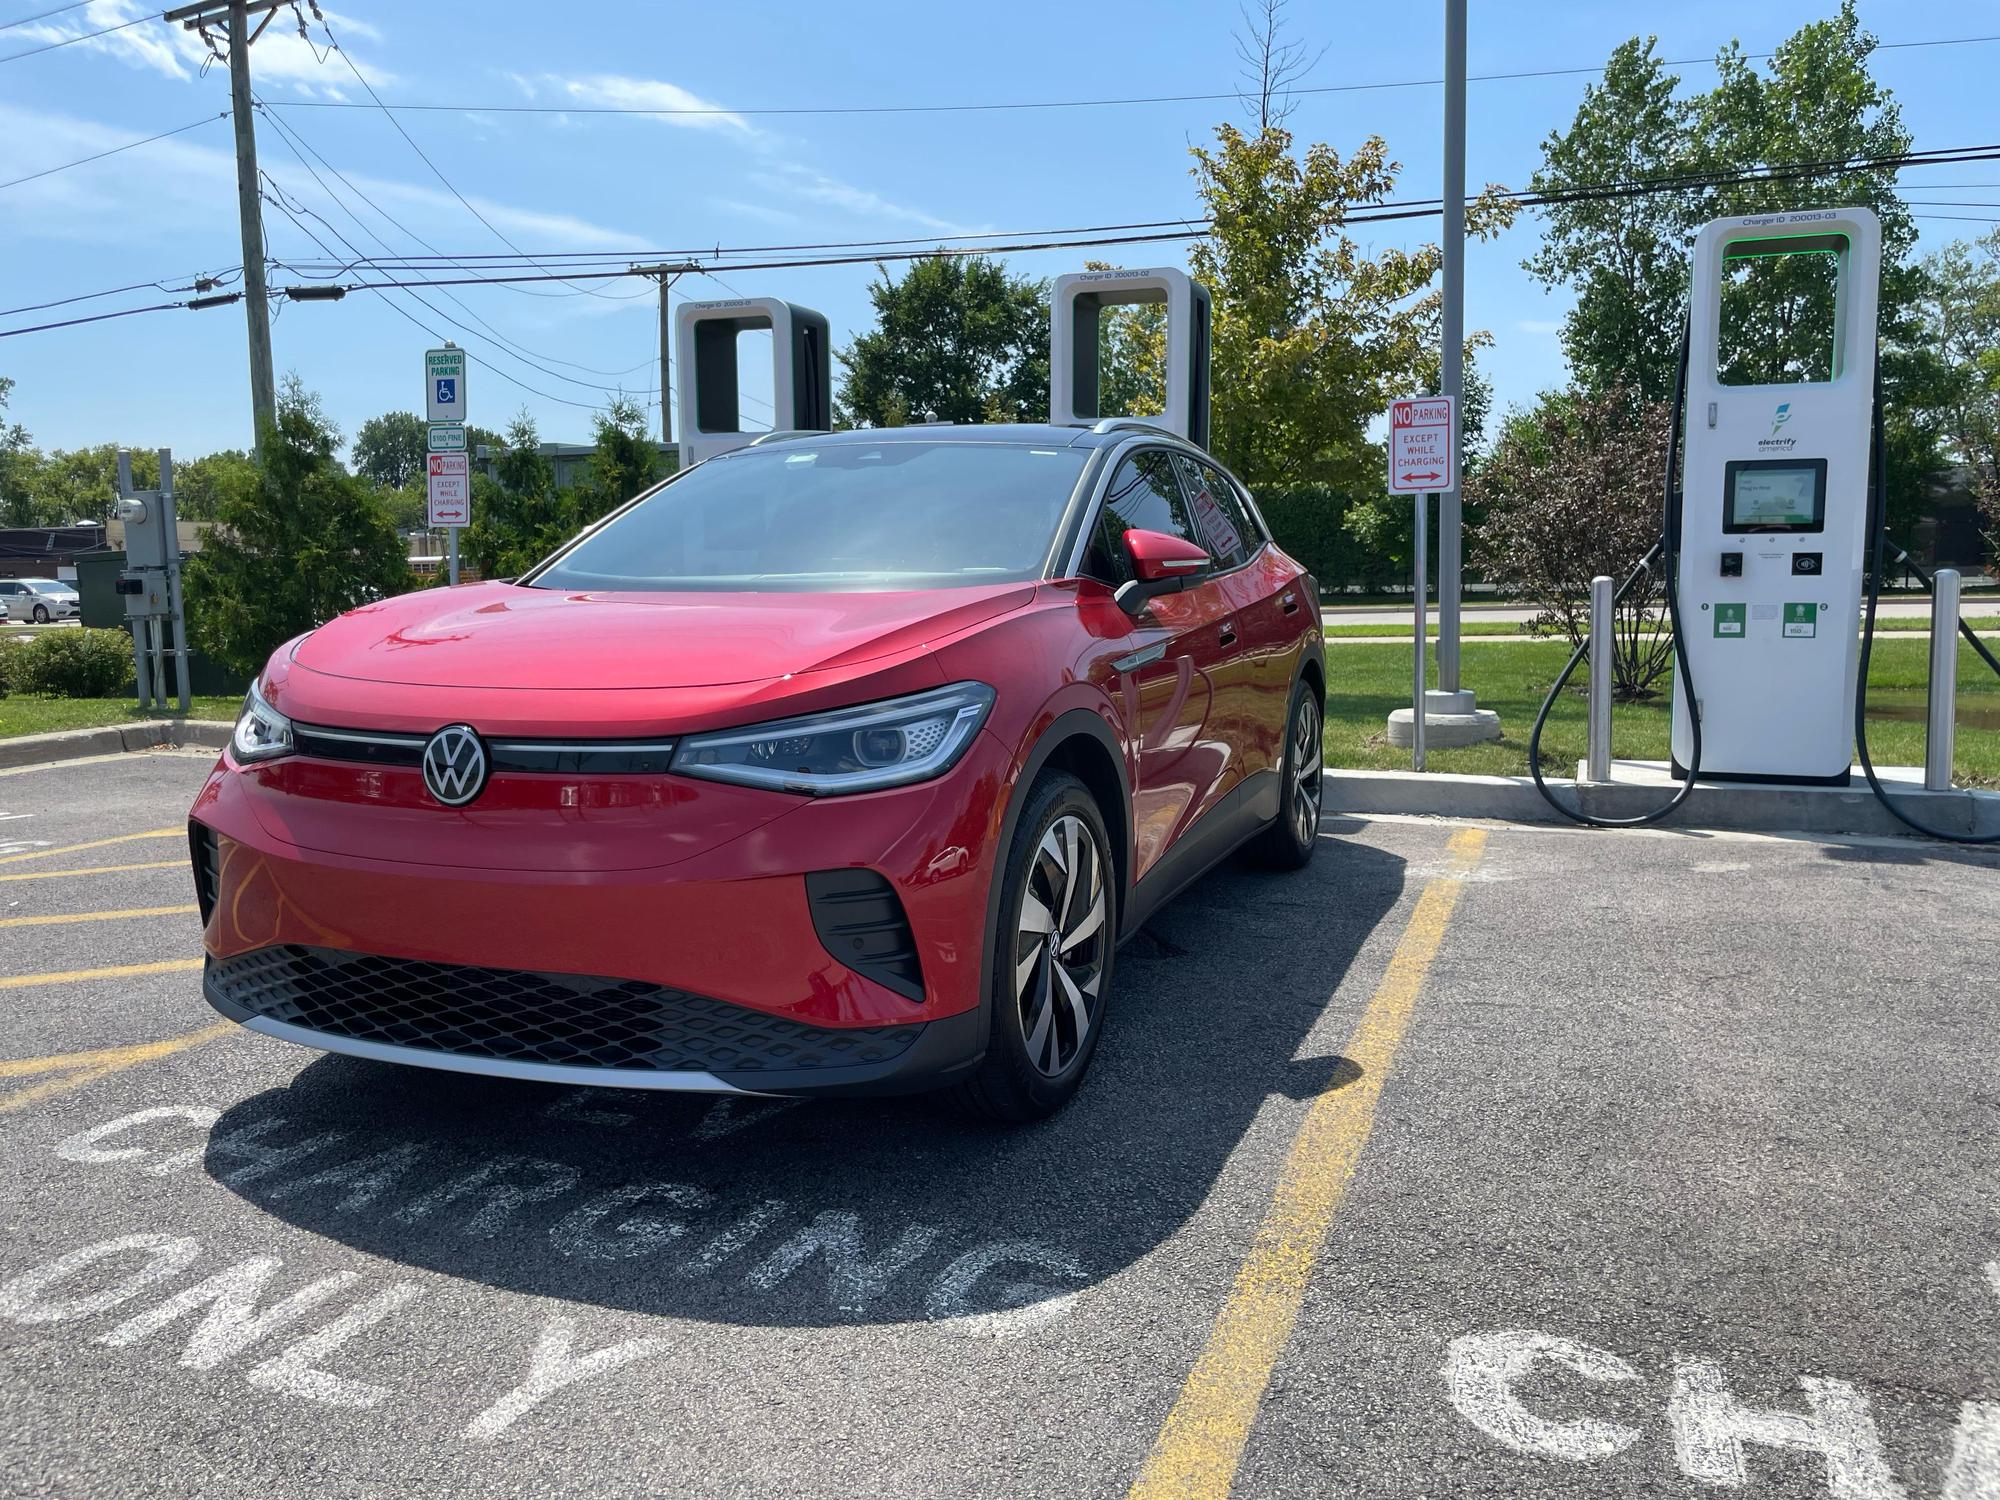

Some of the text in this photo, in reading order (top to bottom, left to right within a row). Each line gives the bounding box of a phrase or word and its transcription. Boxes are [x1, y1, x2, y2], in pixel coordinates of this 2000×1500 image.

[1743, 212, 1837, 226] Charger ID 200013-03
[428, 354, 462, 366] RESERVED
[431, 366, 460, 377] PARKING
[1394, 407, 1447, 425] NO PARKING
[1403, 433, 1439, 444] EXCEPT
[1758, 438, 1797, 447] electrify
[1407, 445, 1435, 455] WHILE
[1758, 444, 1793, 453] america
[431, 459, 465, 473] NO PARKING
[1397, 456, 1445, 467] CHARGING
[434, 498, 465, 506] CHARGING
[54, 1104, 1092, 1339] CHARGING
[0, 1232, 671, 1441] ONLY
